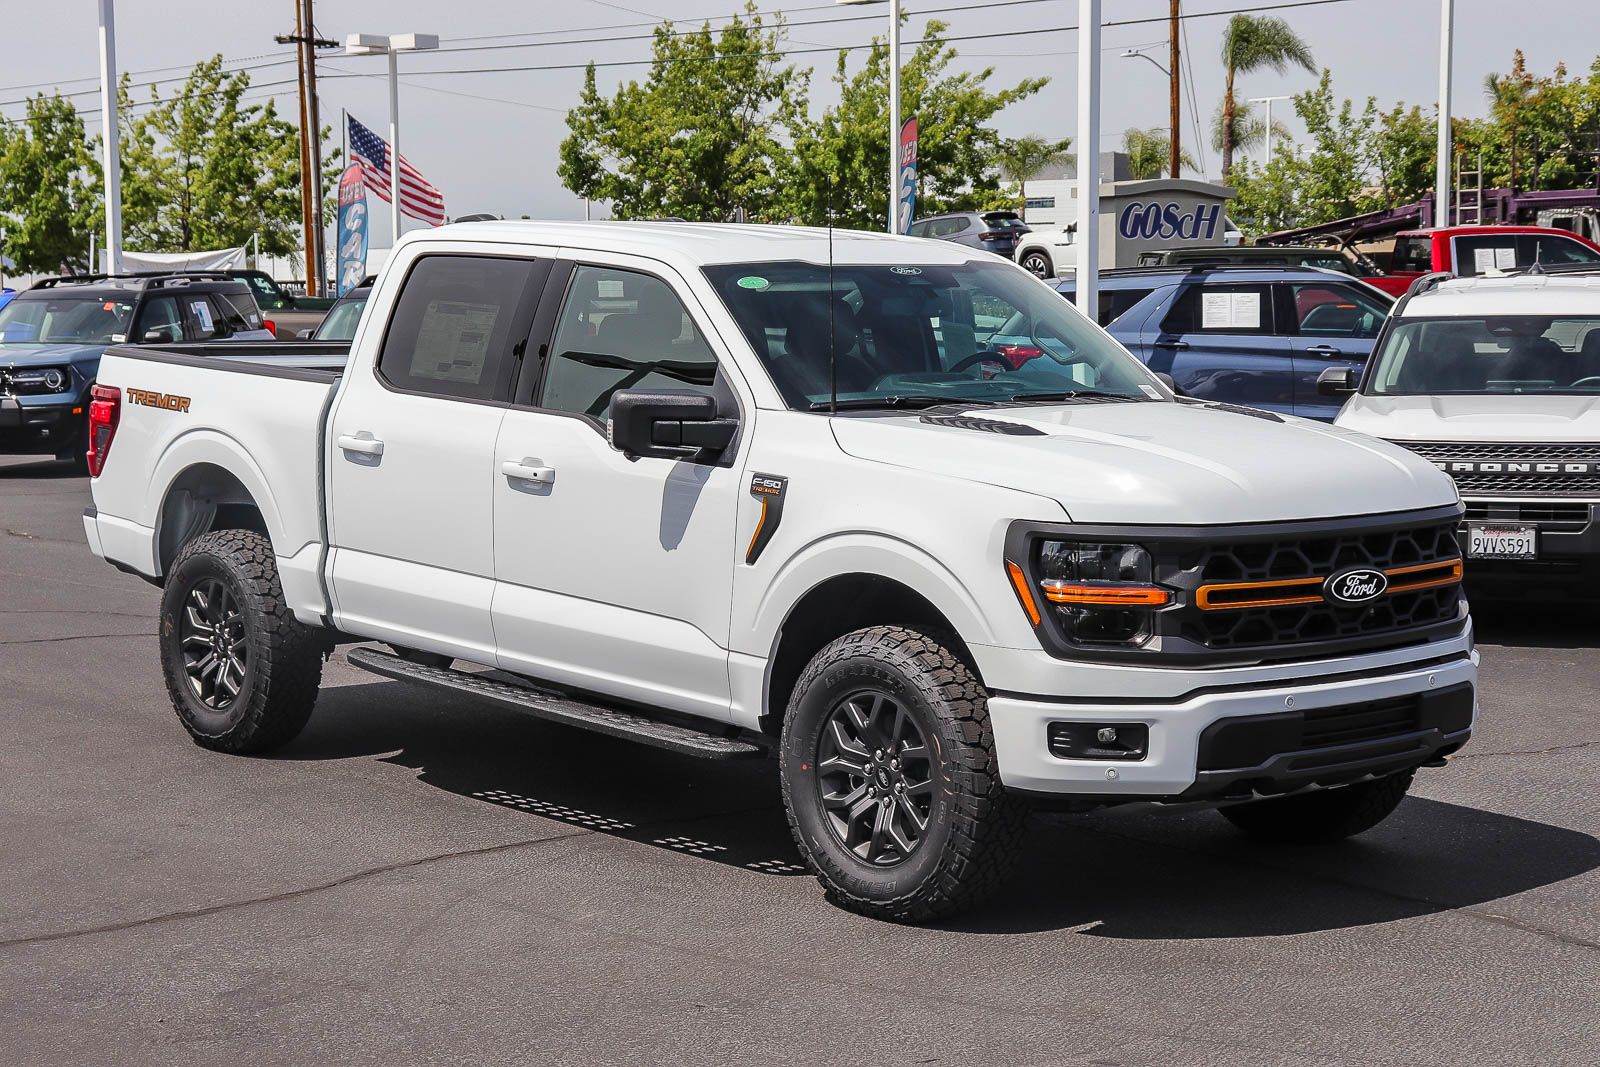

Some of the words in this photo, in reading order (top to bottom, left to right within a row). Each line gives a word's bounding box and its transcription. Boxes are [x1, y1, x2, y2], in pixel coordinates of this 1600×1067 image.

[341, 181, 366, 203] USED
[127, 388, 191, 413] TREMOR
[753, 478, 782, 488] F-150
[1473, 538, 1532, 554] 9VVS591
[1343, 575, 1377, 597] Ford
